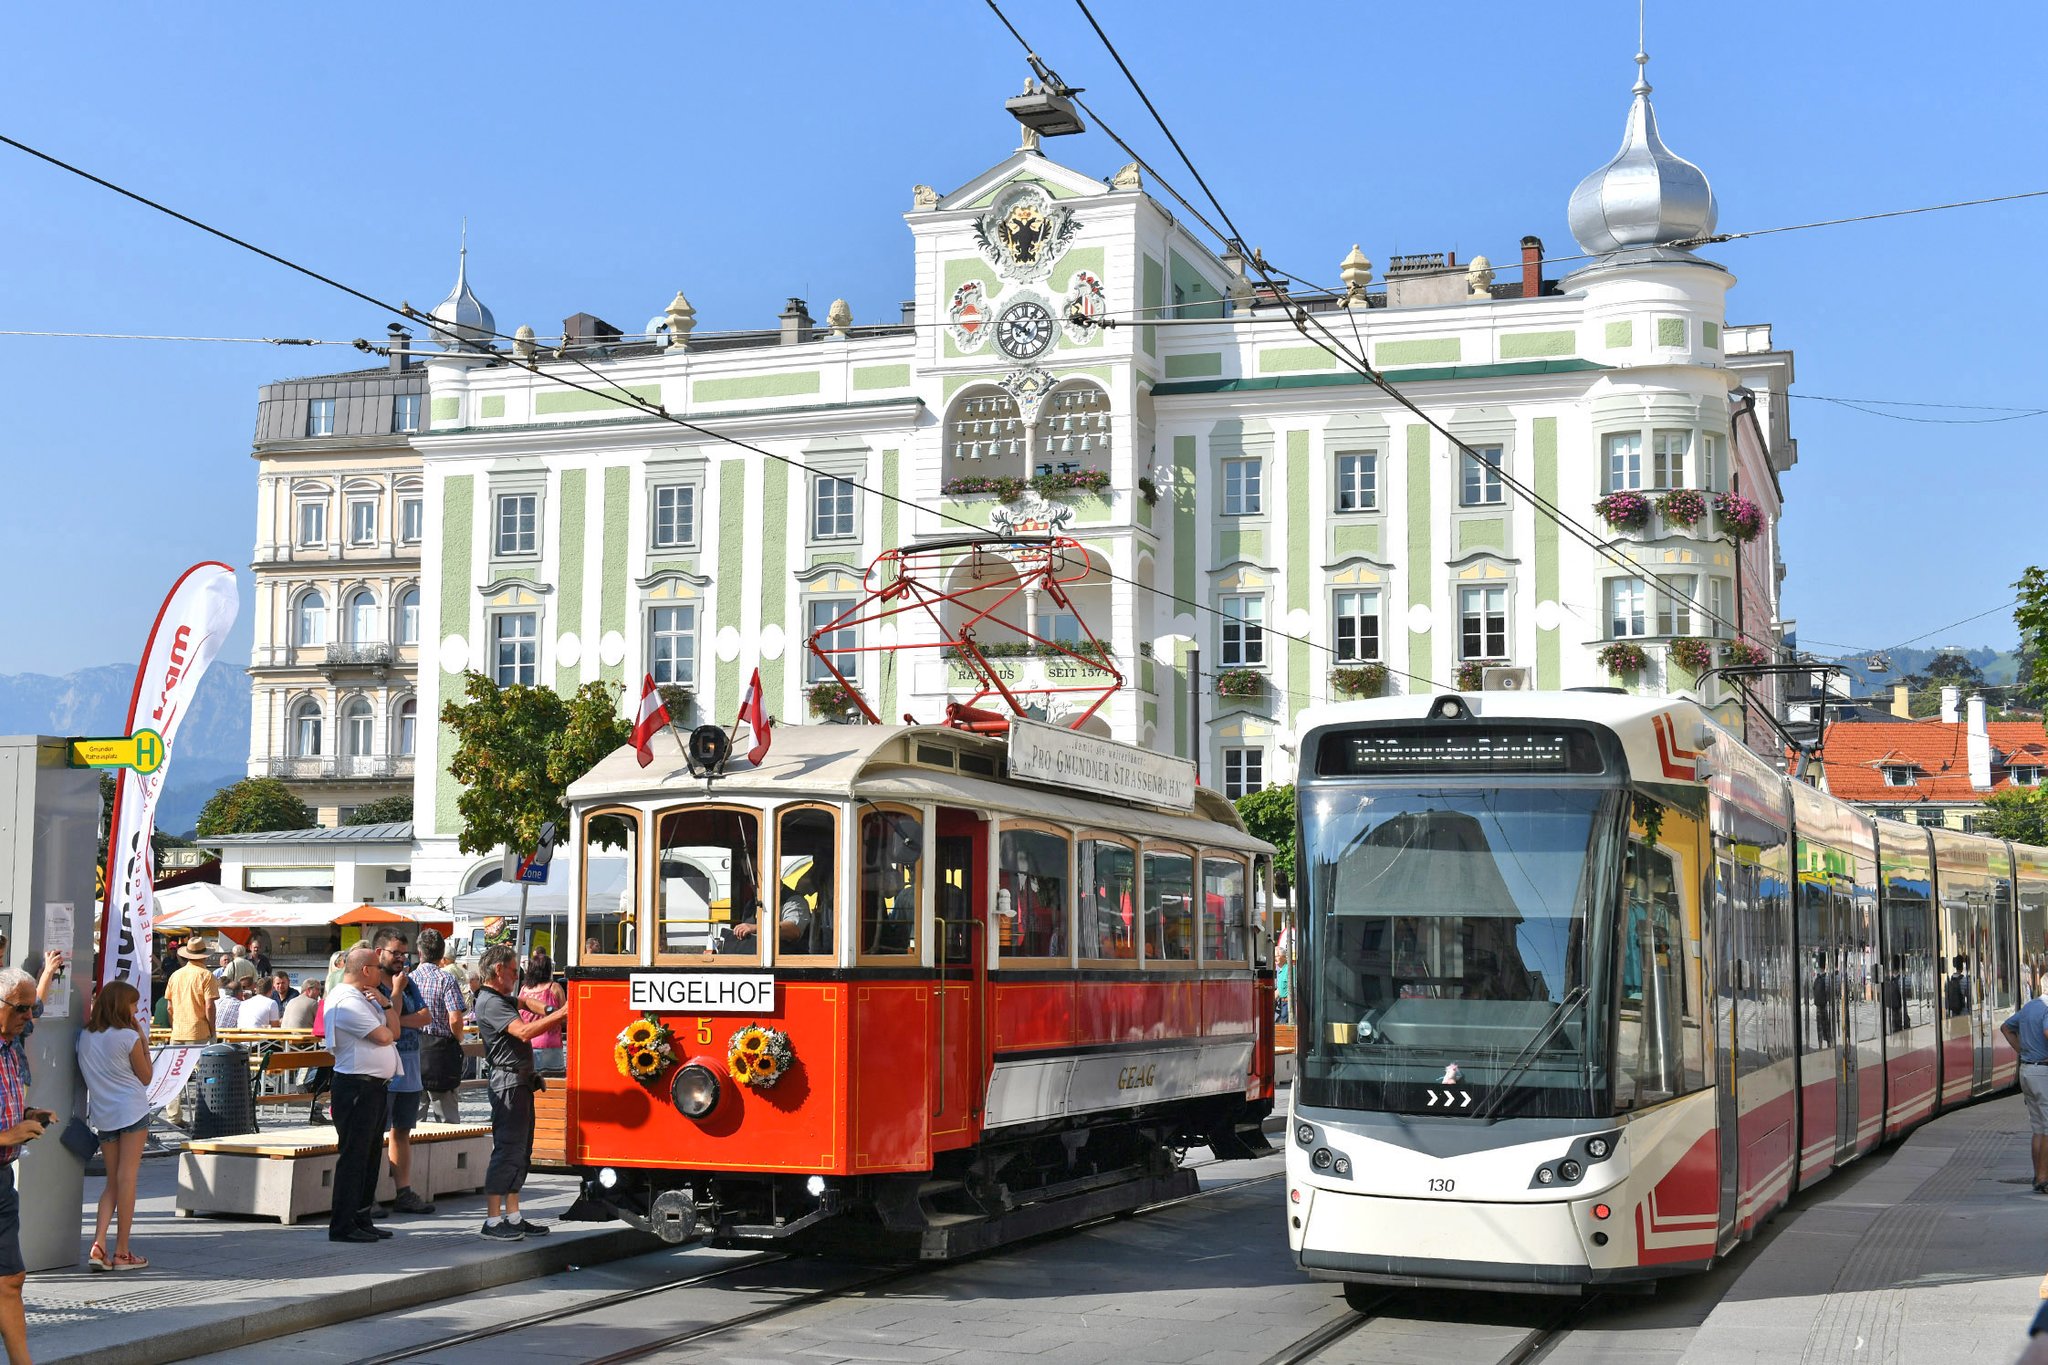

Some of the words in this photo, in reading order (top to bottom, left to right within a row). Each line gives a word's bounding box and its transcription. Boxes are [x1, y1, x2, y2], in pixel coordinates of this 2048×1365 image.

[1048, 668, 1077, 678] SEIT
[1082, 668, 1109, 678] 1574
[137, 738, 154, 766] H
[1056, 749, 1110, 782] GMUNDNER
[522, 867, 542, 879] Zone
[632, 980, 772, 1005] ENGELHOF
[697, 1016, 713, 1045] 5
[1118, 1063, 1156, 1090] GEAG
[1428, 1178, 1456, 1193] 130
